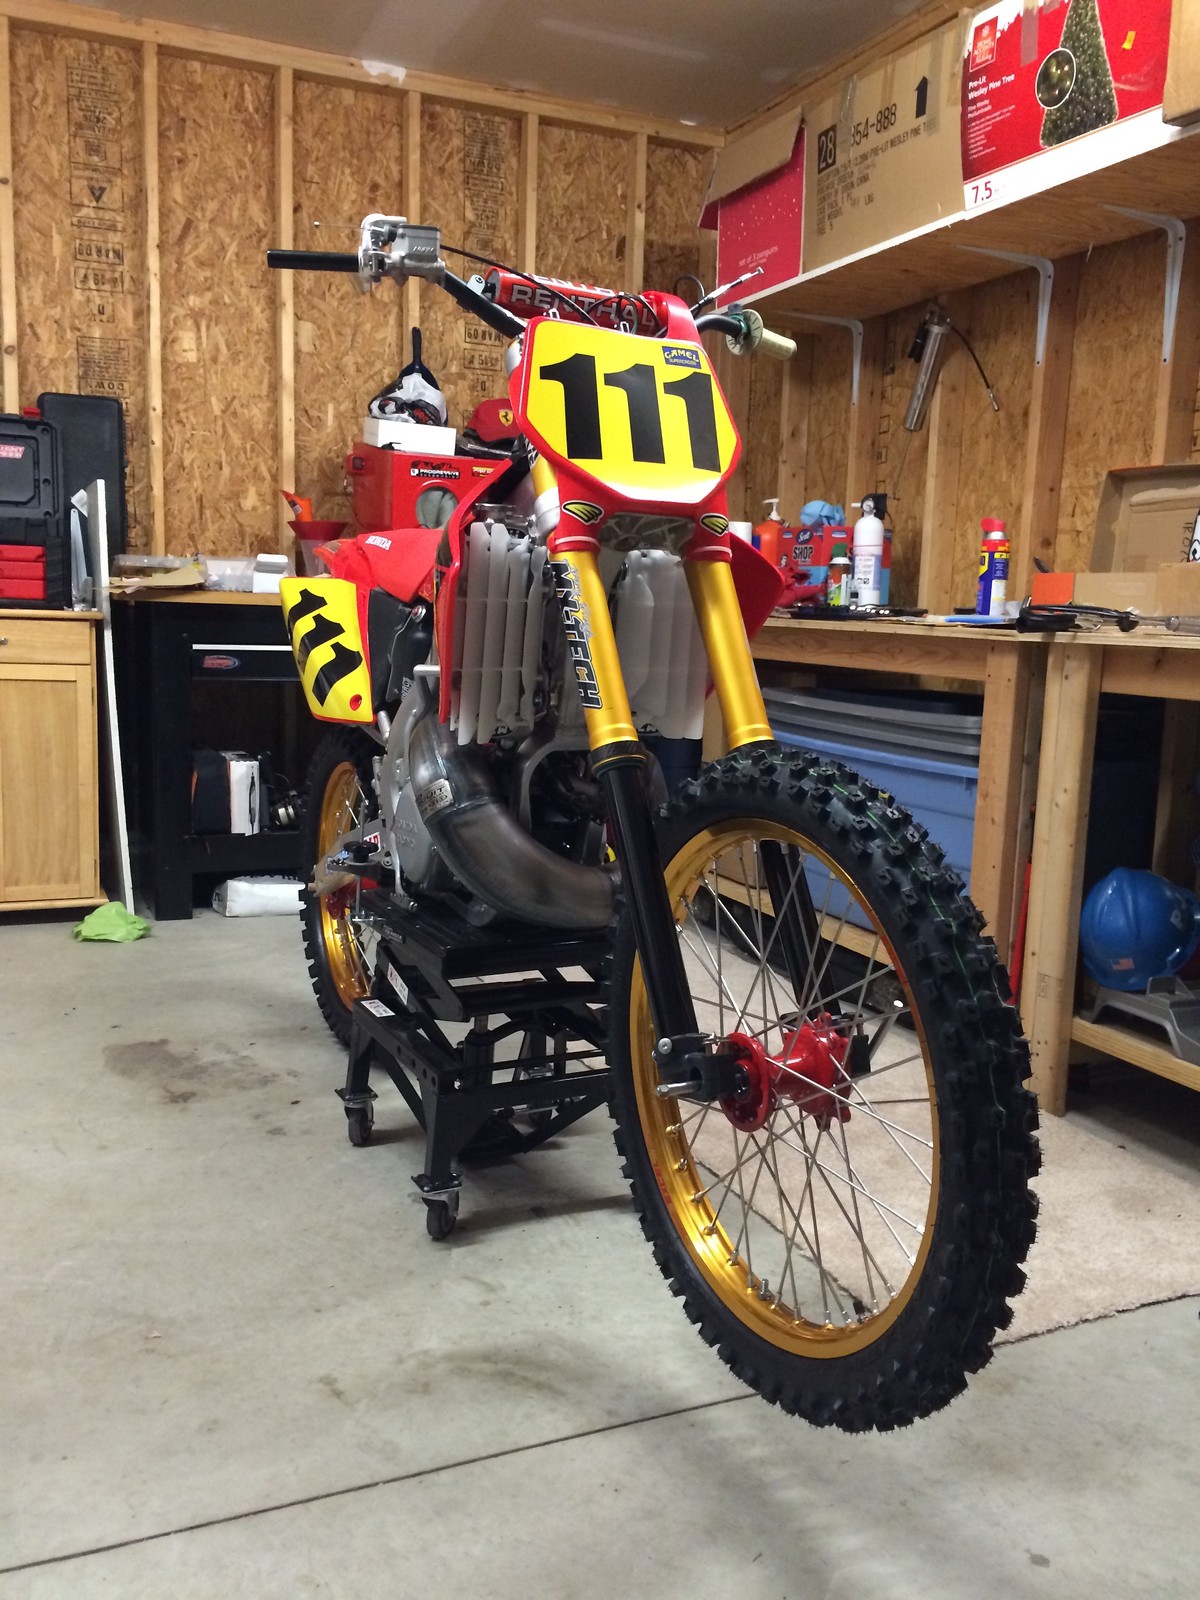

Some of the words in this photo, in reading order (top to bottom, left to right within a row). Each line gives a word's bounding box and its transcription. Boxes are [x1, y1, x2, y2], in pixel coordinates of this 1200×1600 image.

[968, 75, 986, 90] Pre-Lit
[988, 80, 1001, 91] Pine
[1002, 74, 1015, 84] Tree
[890, 132, 909, 148] WESLEY
[910, 126, 922, 139] PINE
[819, 130, 835, 170] 28
[971, 180, 992, 203] 7.5
[511, 284, 655, 327] RENTHAL
[664, 349, 700, 362] CAMEL
[539, 353, 721, 473] 111
[365, 535, 392, 551] HONDA
[793, 546, 813, 560] SHOP
[550, 559, 602, 709] MX-TECH
[287, 588, 363, 707] 111
